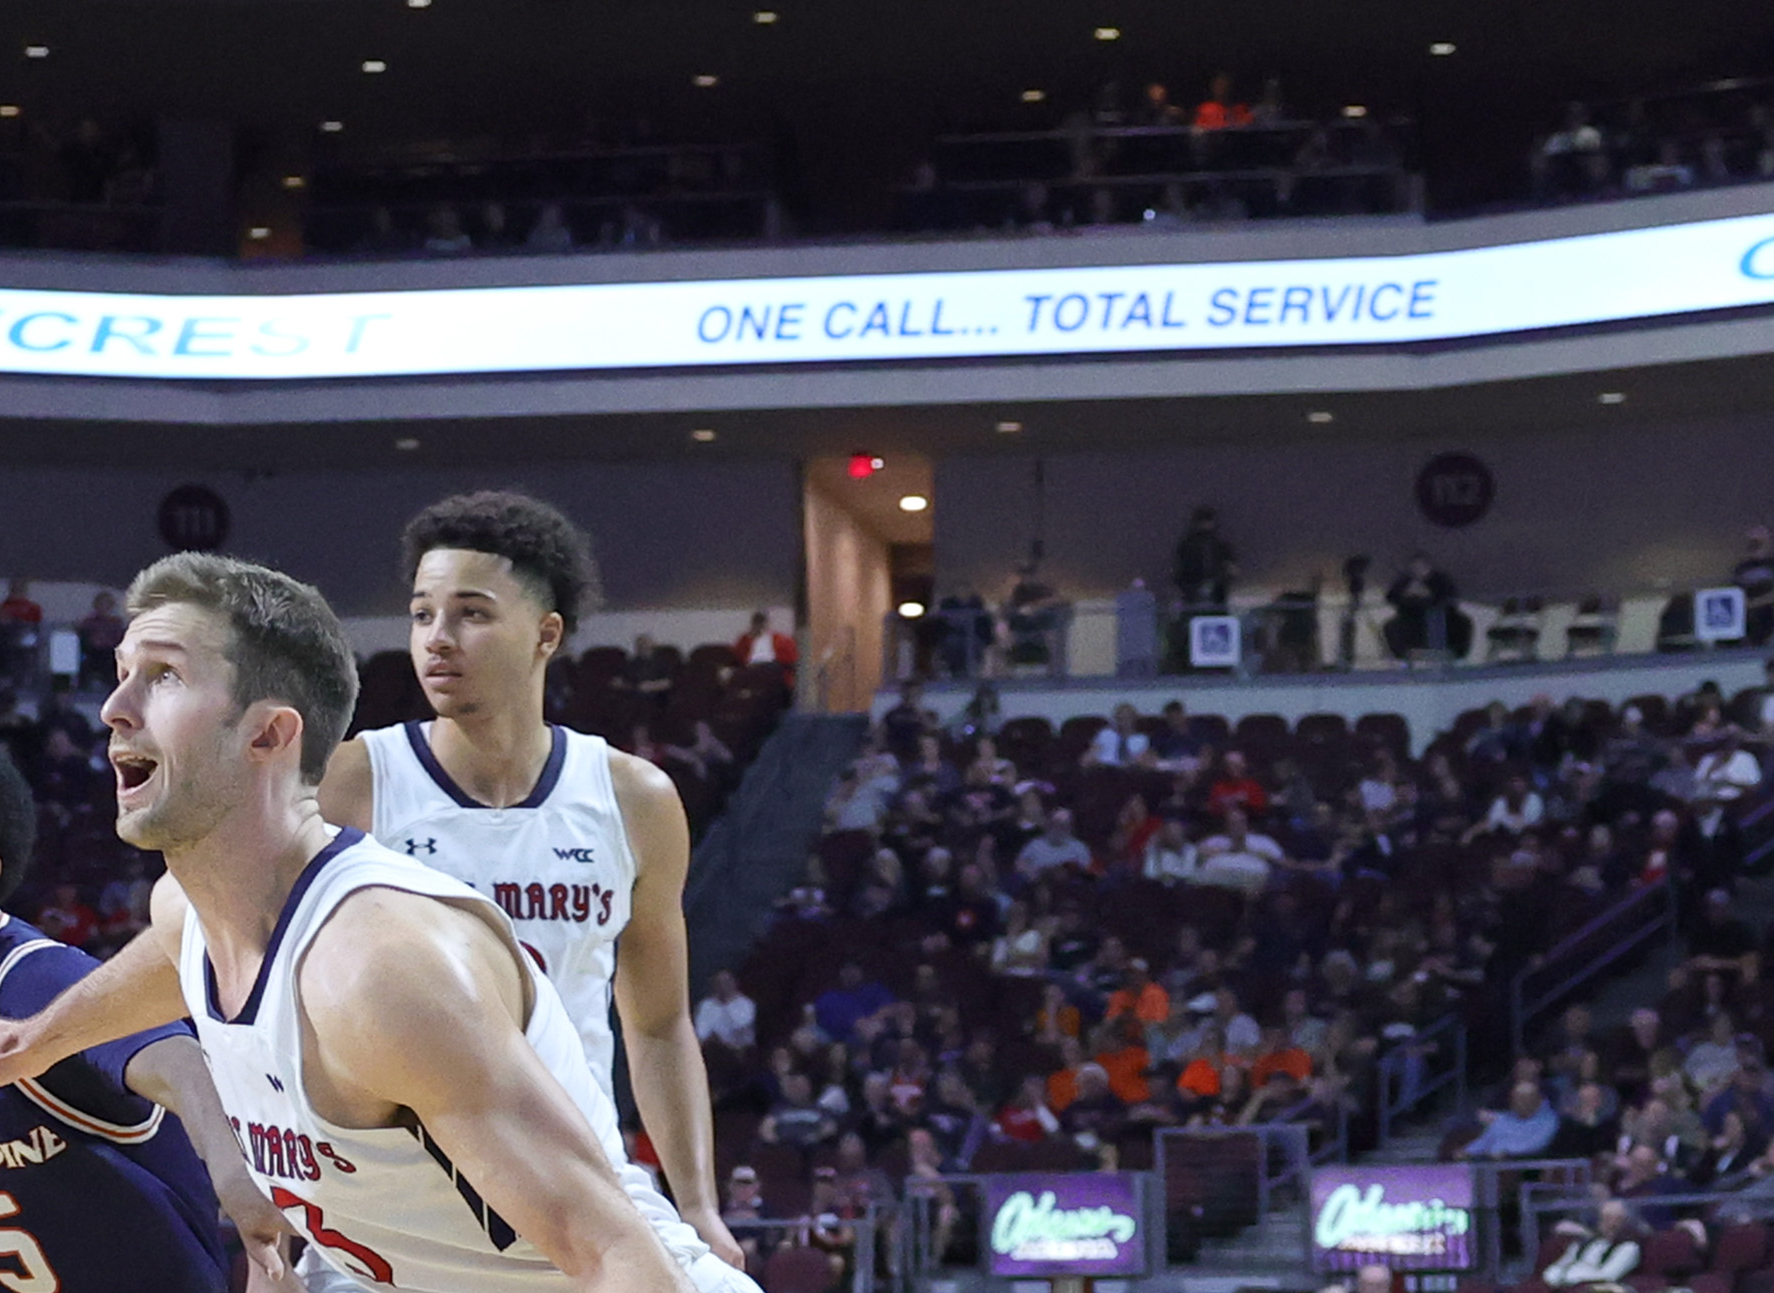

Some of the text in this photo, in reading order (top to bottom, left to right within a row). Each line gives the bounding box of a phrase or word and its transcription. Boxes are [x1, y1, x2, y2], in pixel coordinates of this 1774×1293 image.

[697, 281, 1439, 343] ONE CALL... TOTAL SERVICE
[552, 847, 594, 863] WCC
[492, 880, 614, 927] MARY'S
[247, 1120, 357, 1182] MARY'S
